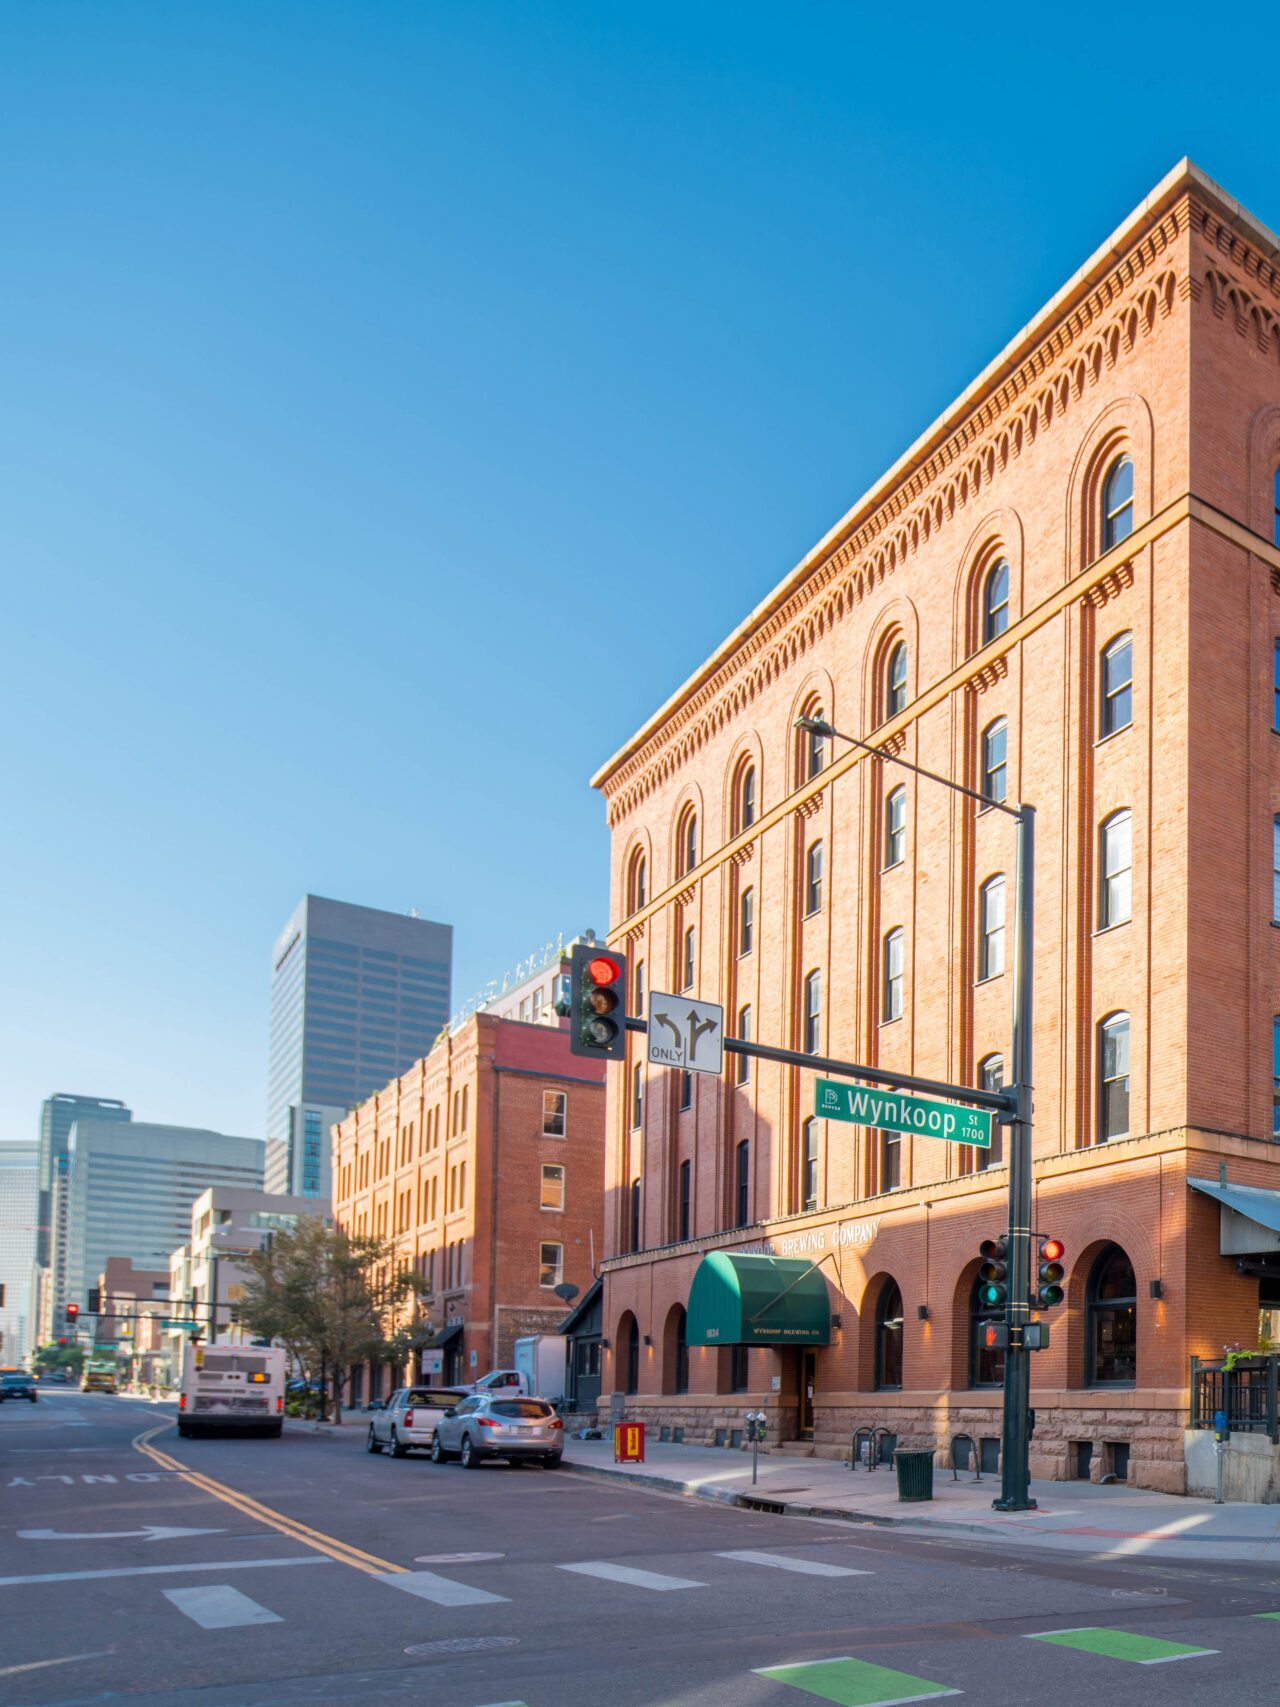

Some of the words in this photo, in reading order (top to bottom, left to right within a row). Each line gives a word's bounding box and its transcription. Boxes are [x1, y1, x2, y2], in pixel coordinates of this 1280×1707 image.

[651, 1046, 683, 1061] ONLY
[848, 1090, 956, 1137] Wynkoop
[968, 1114, 978, 1126] St
[961, 1127, 984, 1140] 1700
[781, 1231, 825, 1257] BREWING
[832, 1217, 882, 1246] COMPANY
[7, 1473, 161, 1488] ONLY
